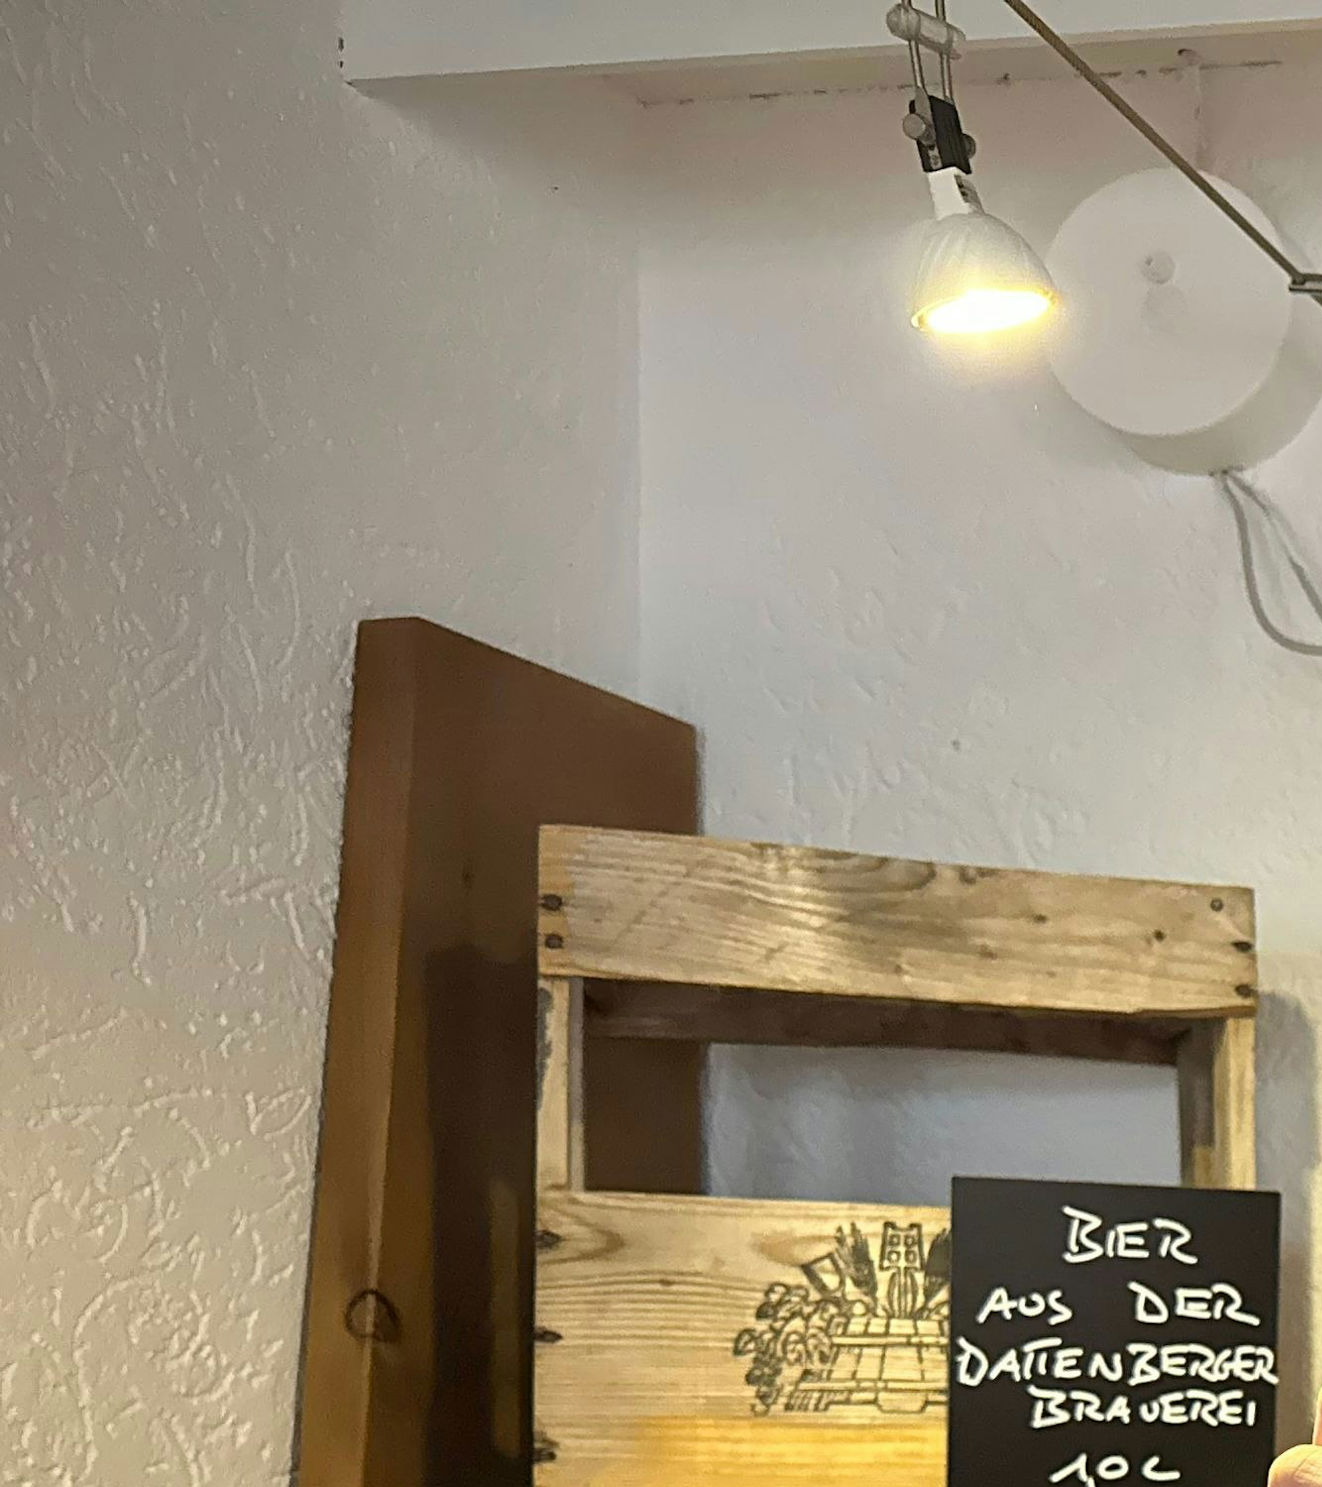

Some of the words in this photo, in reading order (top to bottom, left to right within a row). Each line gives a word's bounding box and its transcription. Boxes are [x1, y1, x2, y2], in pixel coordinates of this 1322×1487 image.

[1062, 1205, 1198, 1264] BIER
[976, 1286, 1072, 1325] AUS
[1128, 1281, 1260, 1326] DER
[956, 1337, 1280, 1387] DATTENBERGER
[1027, 1385, 1256, 1429] BRAUEREI
